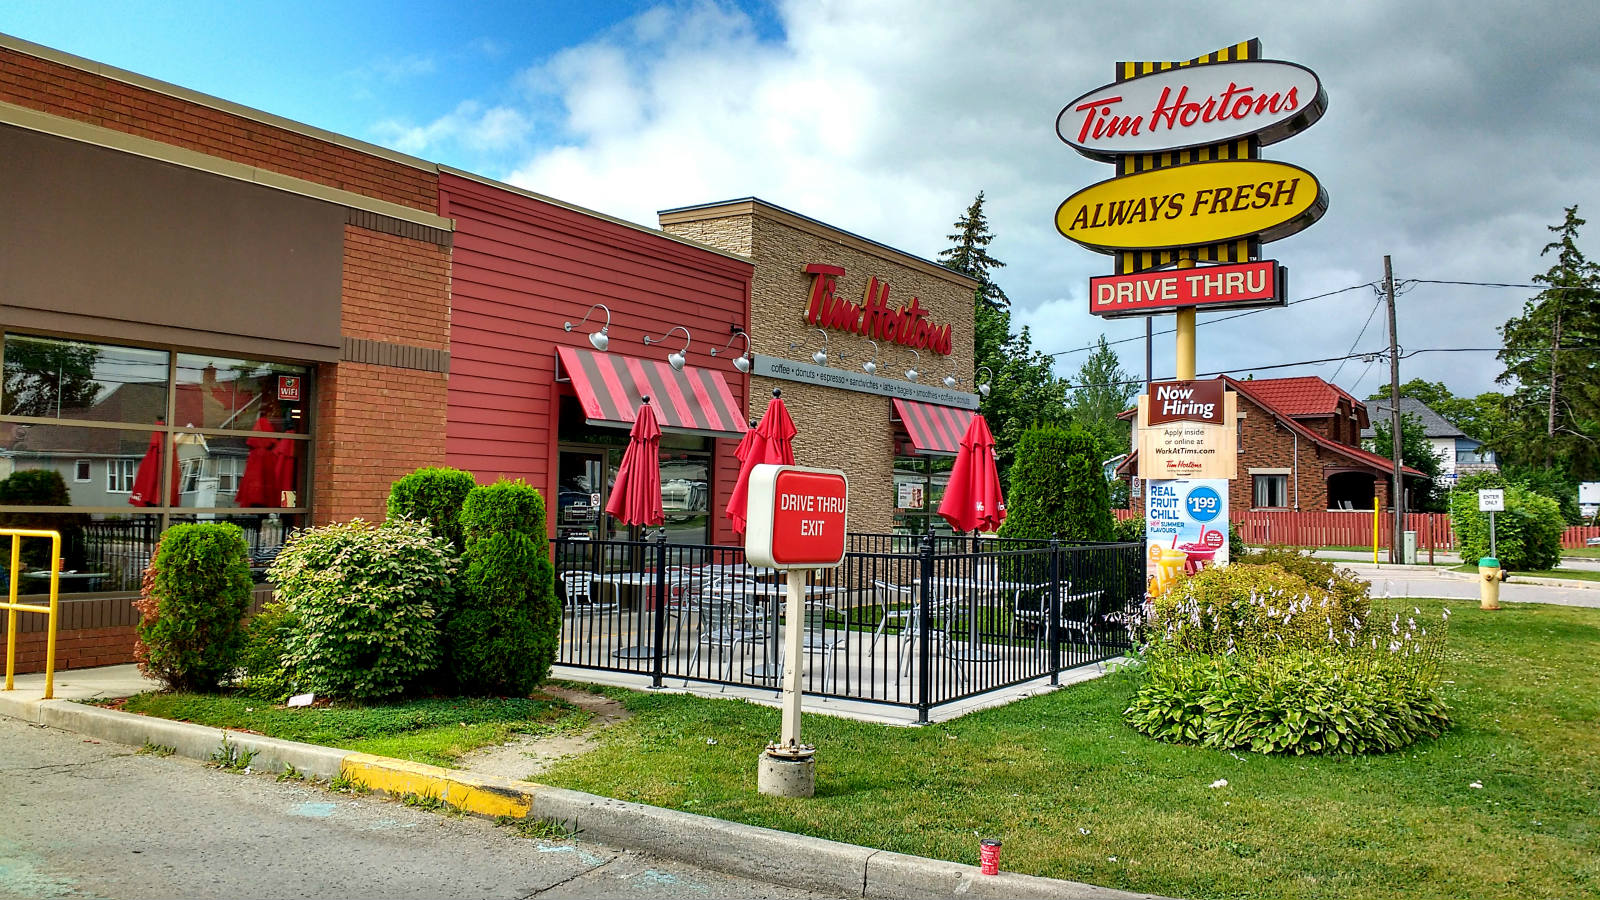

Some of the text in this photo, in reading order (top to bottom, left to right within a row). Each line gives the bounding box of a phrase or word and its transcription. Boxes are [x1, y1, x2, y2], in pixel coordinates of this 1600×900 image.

[1076, 82, 1299, 144] Tim Hortons
[1069, 178, 1300, 231] ALWAYS FRESH
[1097, 269, 1266, 305] DRIVE THRU
[803, 263, 952, 355] Tim Hortons
[771, 363, 790, 375] coffee
[796, 368, 815, 379] donuts
[820, 372, 844, 384] espresso
[849, 378, 879, 390] sandwiches
[1157, 386, 1194, 400] Now
[1163, 400, 1215, 418] Hiring
[1165, 429, 1182, 437] Apply
[1151, 486, 1176, 496] REAL
[781, 493, 844, 513] DRIVE THRU
[1151, 498, 1179, 508] FRUIT
[1150, 509, 1179, 519] CHILL
[801, 520, 824, 536] EXIT
